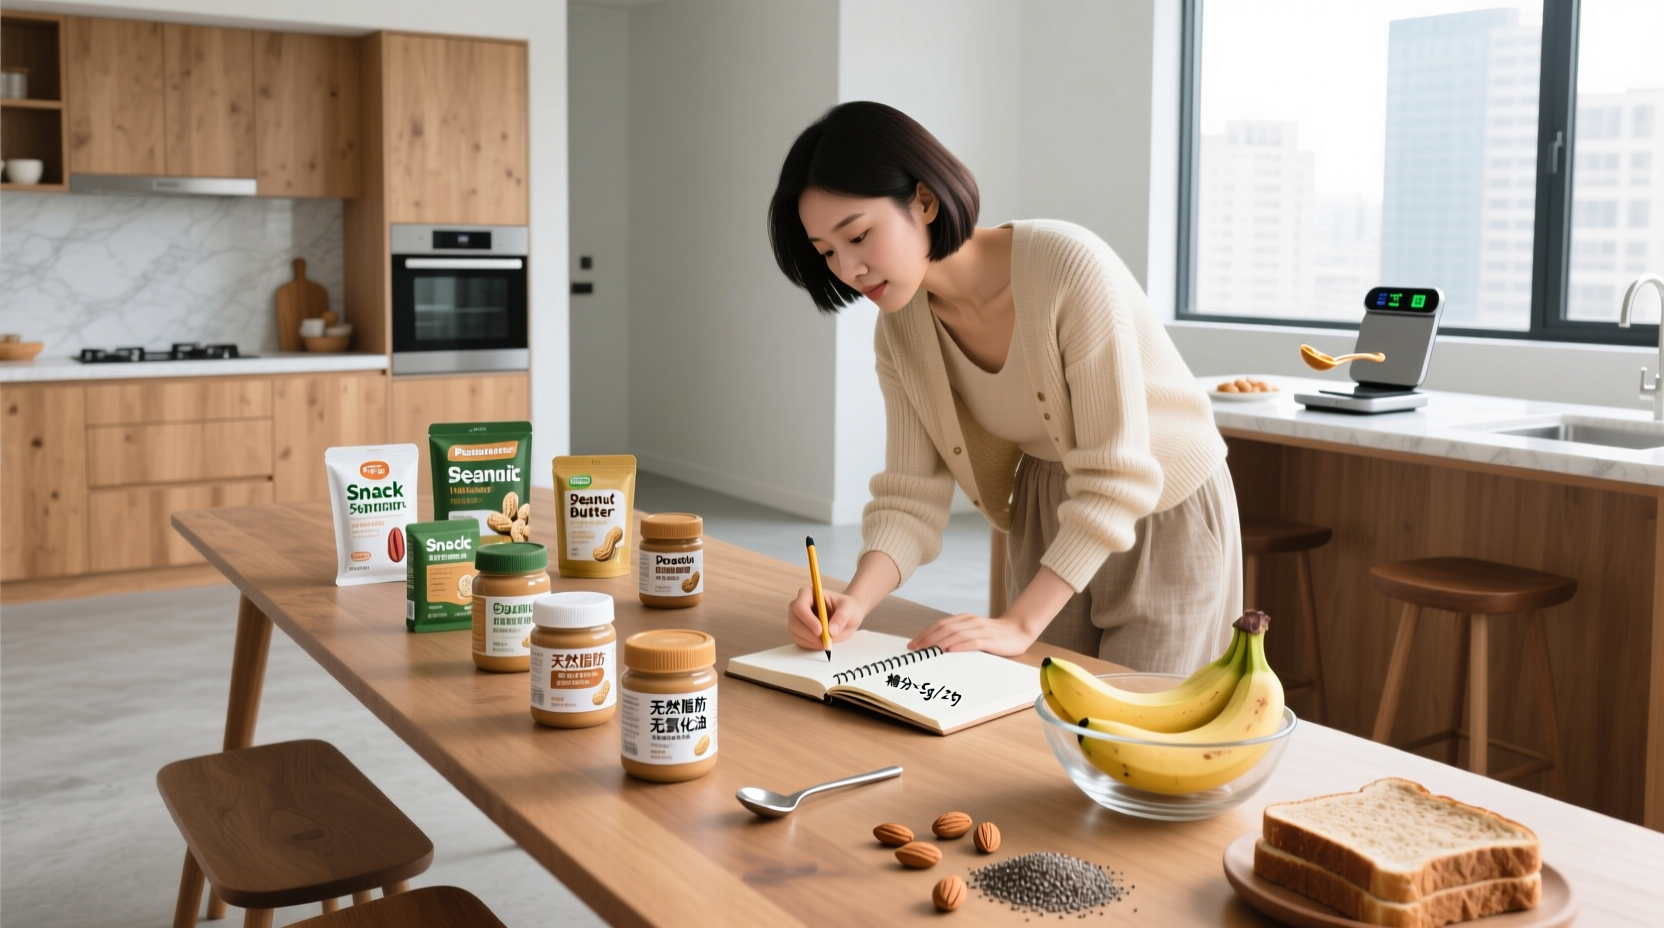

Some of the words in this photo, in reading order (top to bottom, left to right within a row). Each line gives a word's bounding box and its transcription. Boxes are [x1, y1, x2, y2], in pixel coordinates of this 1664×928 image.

[346, 481, 404, 501] Snack
[570, 507, 615, 518] Butter
[551, 652, 606, 669] 天然脂肪
